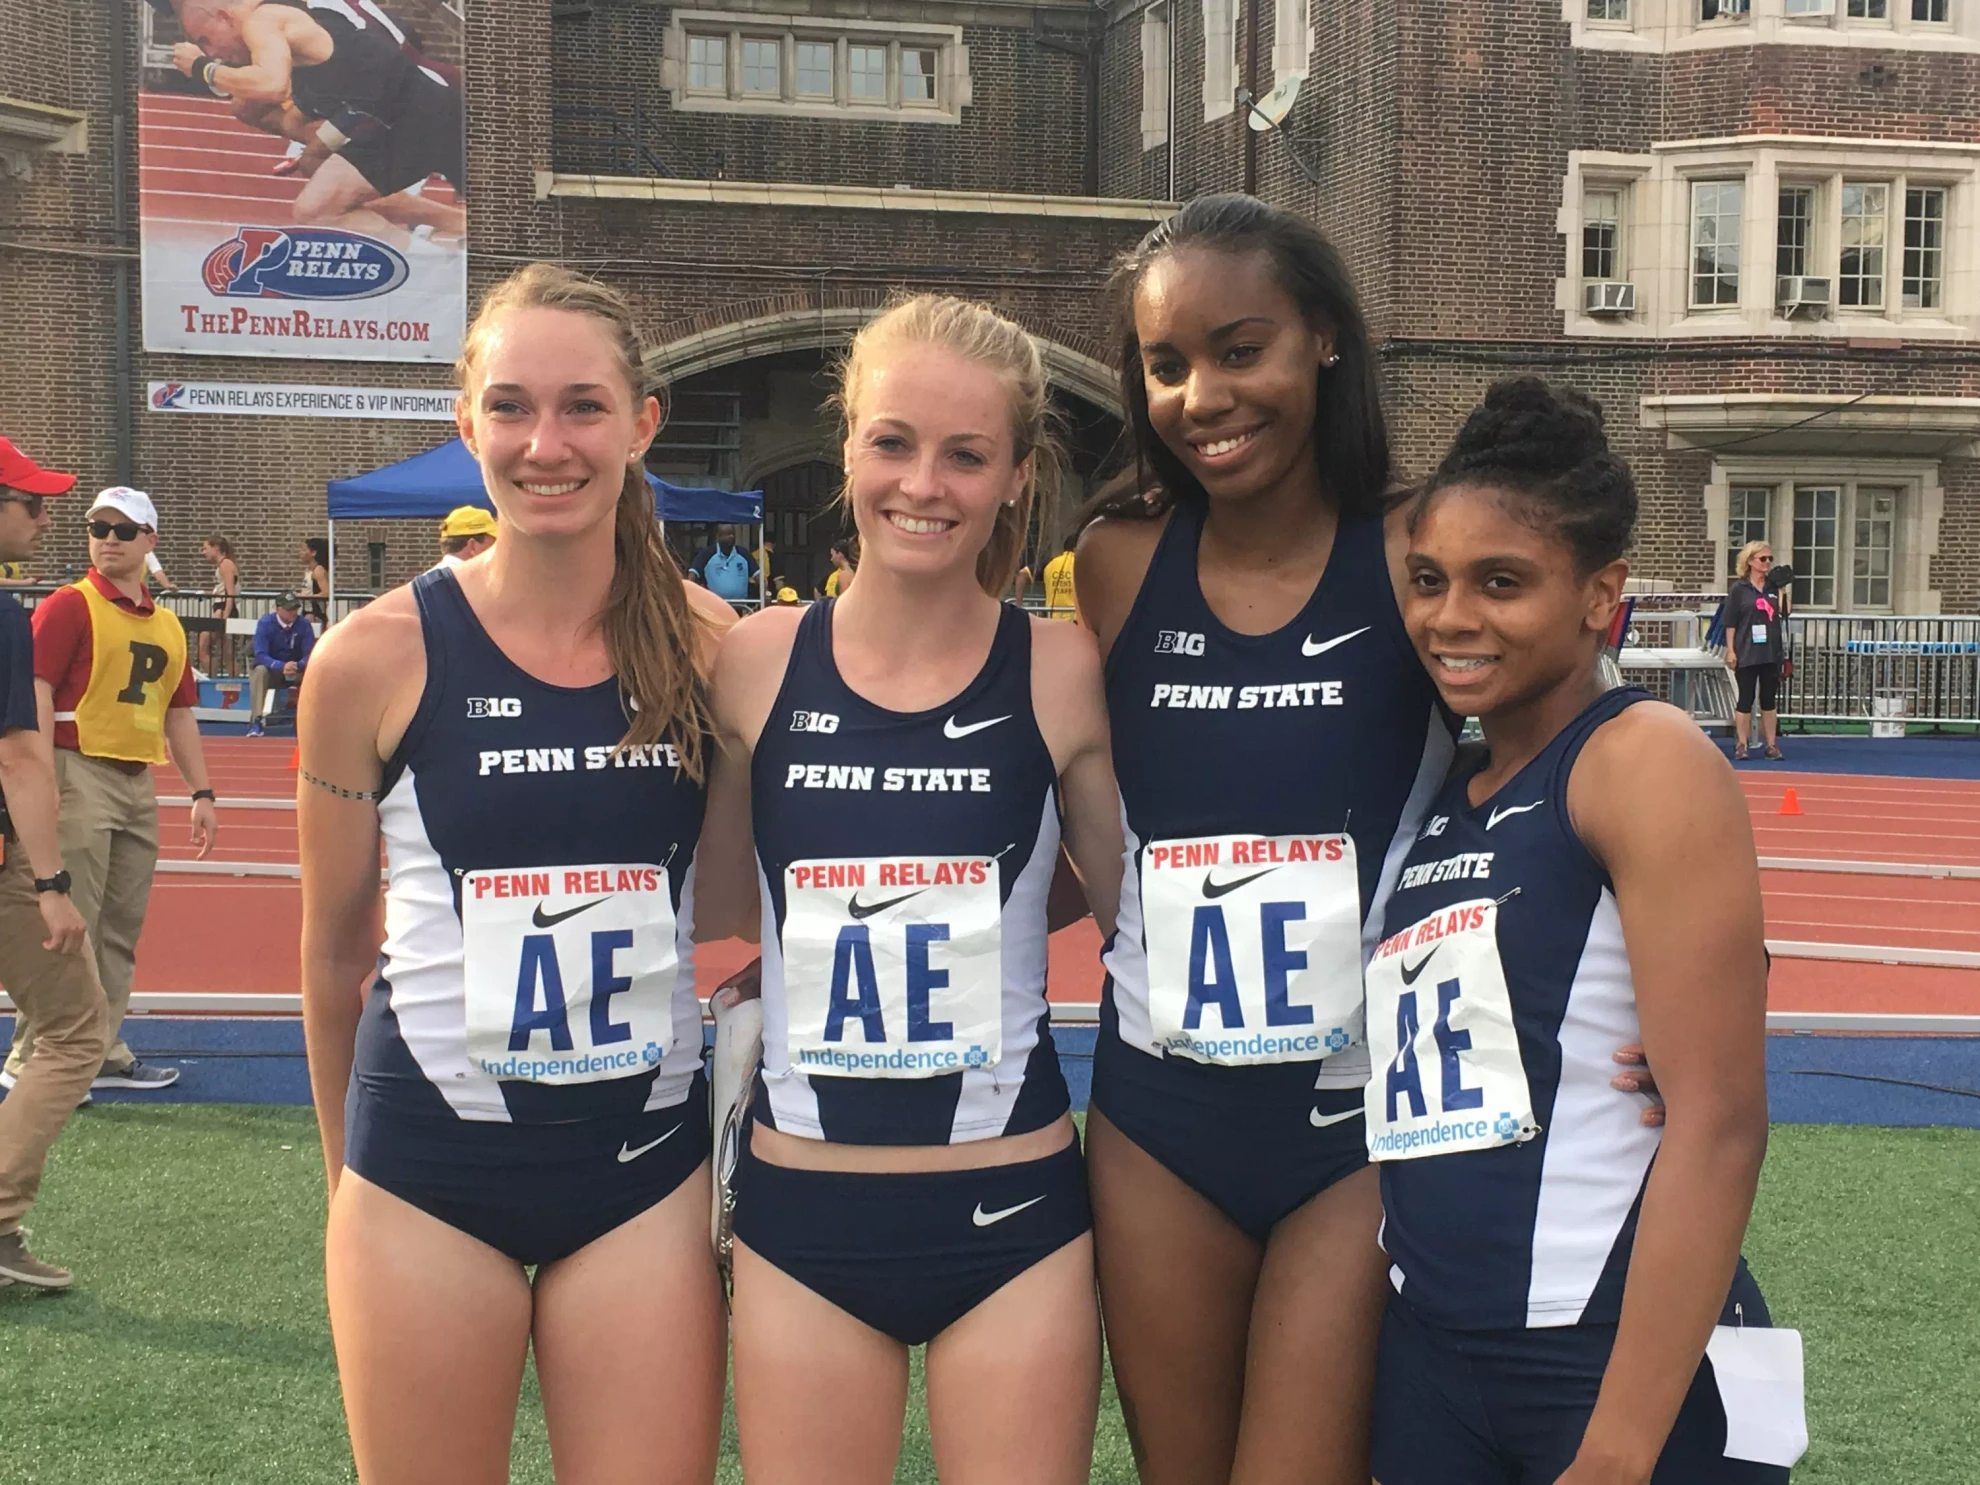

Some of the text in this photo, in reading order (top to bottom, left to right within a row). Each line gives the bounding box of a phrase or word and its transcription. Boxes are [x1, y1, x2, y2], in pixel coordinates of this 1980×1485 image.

[293, 240, 363, 260] PENN
[286, 260, 381, 281] RELAYS
[189, 389, 225, 406] PENN
[228, 390, 274, 408] RELAYS
[276, 392, 353, 410] EXPERIENCE
[356, 395, 365, 410] &
[367, 395, 388, 411] VIP
[117, 641, 169, 706] P
[1150, 681, 1343, 709] PENN STATE
[479, 744, 683, 775] PENN STATE
[784, 764, 991, 792] PENN STATE
[1153, 838, 1343, 869] PENN RELAYS
[474, 869, 658, 899] PENN RELAYS
[795, 861, 987, 889] PENN RELAYS
[1397, 852, 1495, 891] PENN STATE
[1373, 905, 1485, 961] PENN RELAYS
[1182, 901, 1314, 1030] AE
[507, 929, 634, 1052] AE
[823, 923, 954, 1043] AE
[481, 1050, 638, 1080] Independence
[799, 1048, 958, 1072] Independence
[1386, 977, 1483, 1123] AE
[1371, 1119, 1488, 1154] Independence
